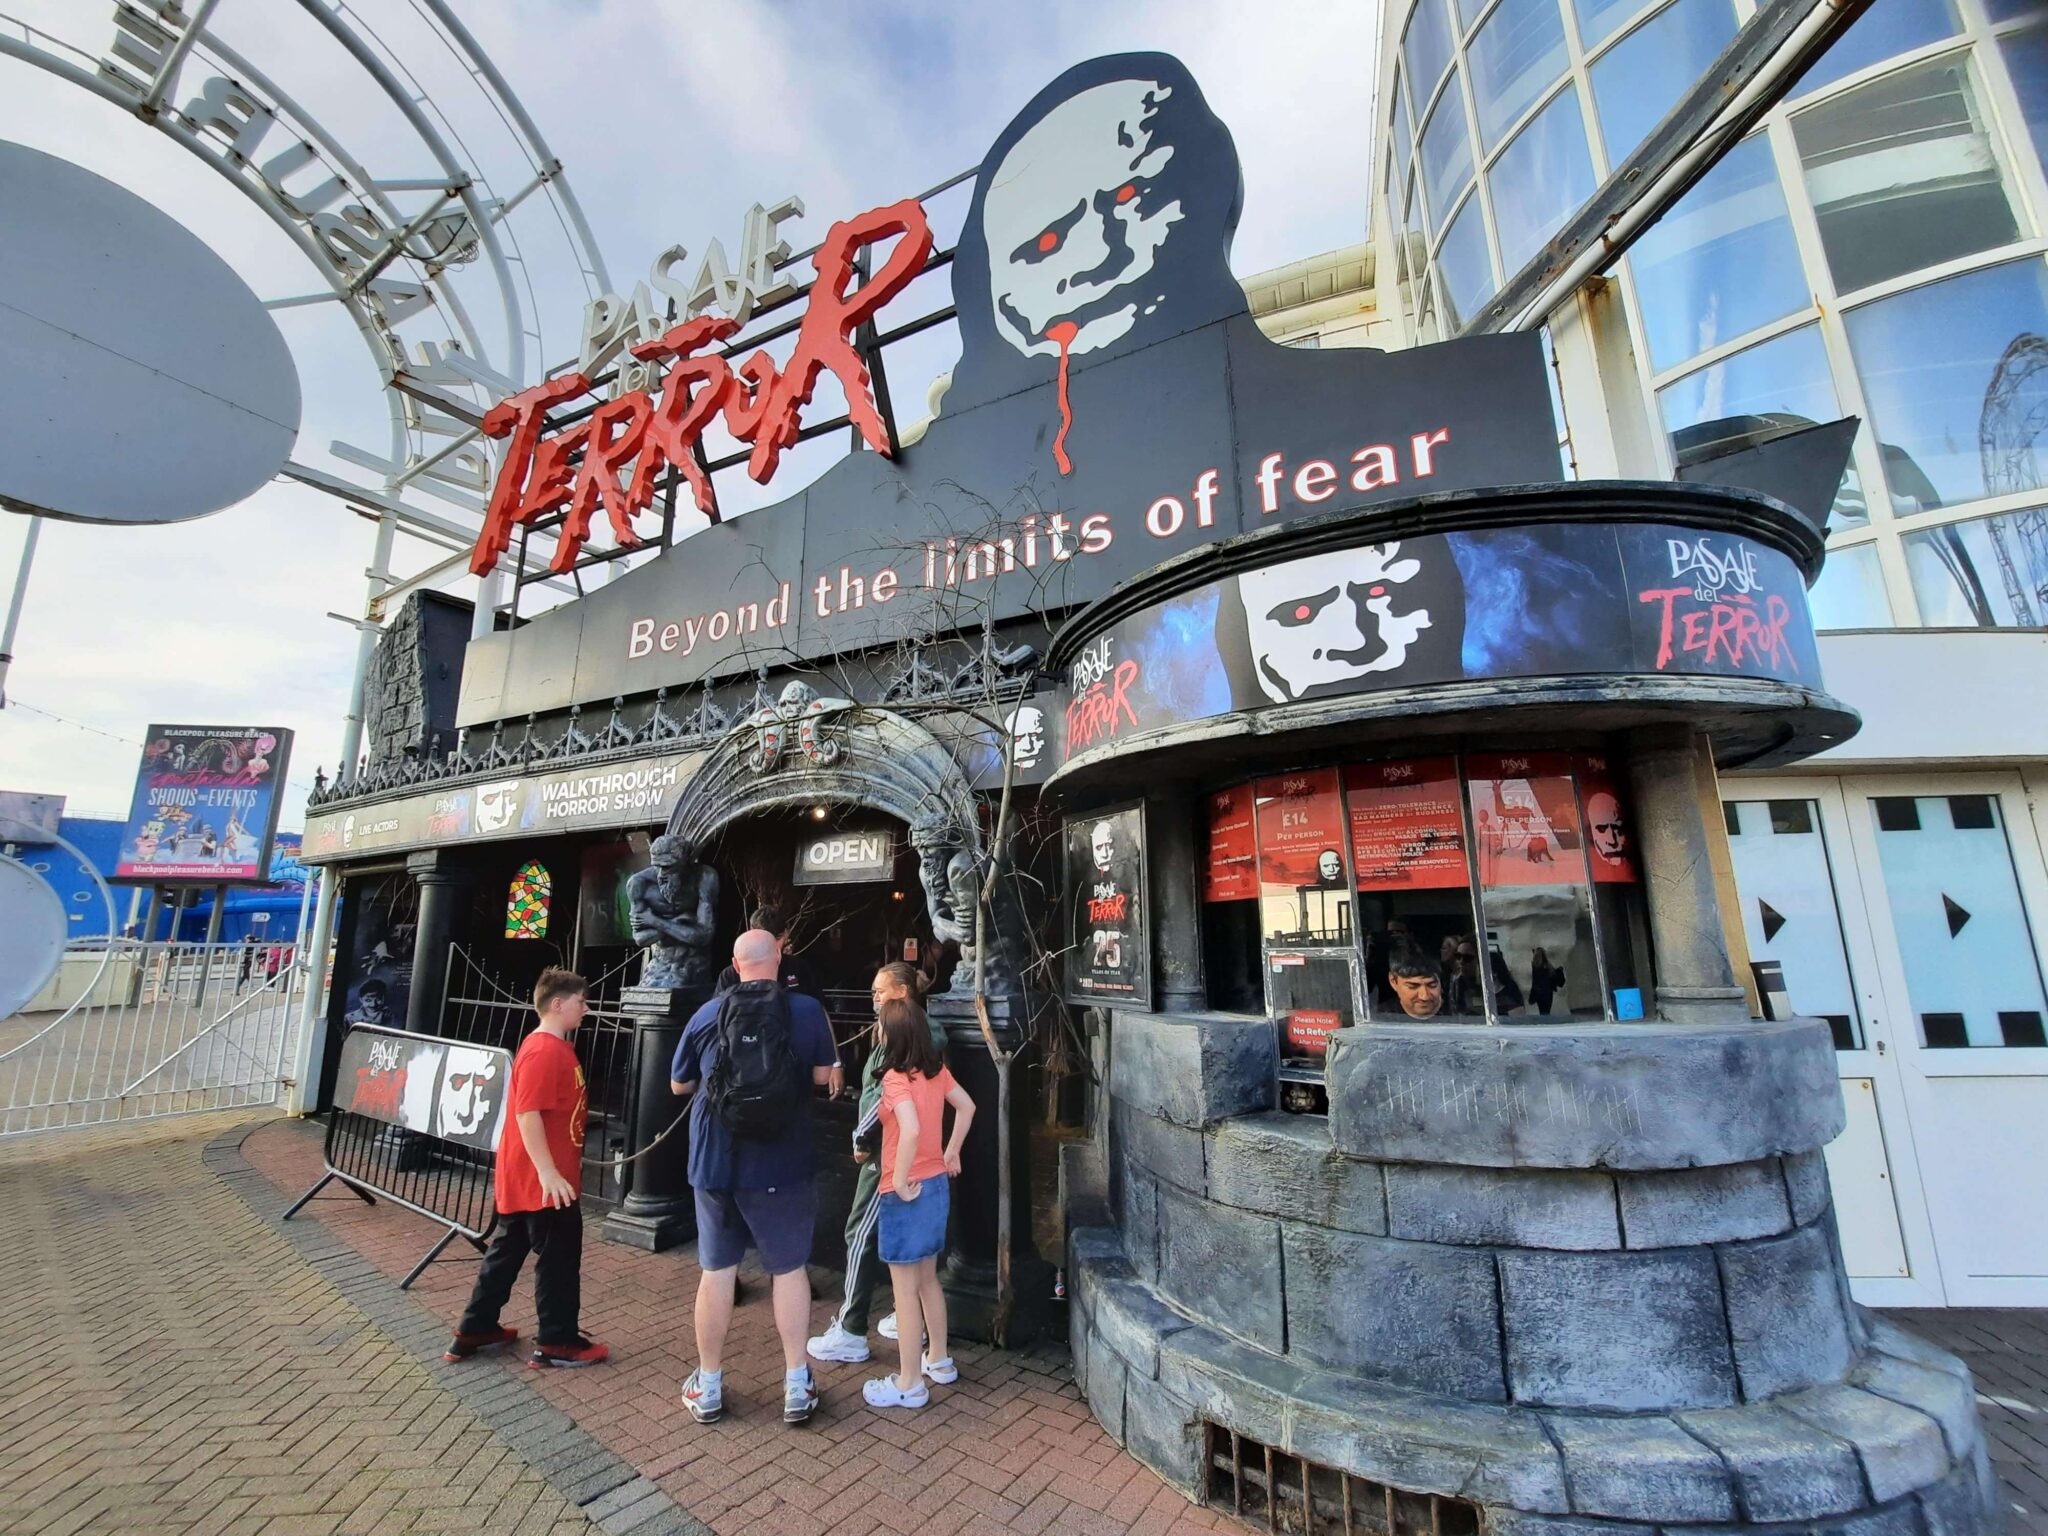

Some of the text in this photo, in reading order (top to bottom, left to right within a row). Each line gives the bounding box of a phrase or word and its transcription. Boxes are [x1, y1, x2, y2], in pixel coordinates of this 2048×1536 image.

[579, 195, 805, 376] PASAJE
[468, 198, 935, 577] TERROR
[626, 426, 1450, 662] Beyond the limits of fear
[1666, 537, 1764, 594] PASAJE
[1694, 581, 1722, 603] del
[1639, 587, 1799, 675] TERROR
[1072, 635, 1114, 695] PASAJE
[1064, 660, 1138, 763] TERROR
[164, 729, 269, 739] BLACKPOOL PLEASURE BEACH
[148, 788, 258, 807] SHOWS EVENTS
[542, 766, 676, 802] WALKTHROUGH
[546, 788, 665, 818] HORROR SHOW
[359, 819, 399, 836] LIVE ACTORS
[1277, 830, 1324, 841] PER PERSON
[809, 838, 879, 865] OPEN
[133, 864, 242, 875] blackpoolpleasurebeach.com
[1087, 894, 1126, 923] TERROR
[1093, 930, 1121, 968] 25
[1293, 1027, 1327, 1036] No Refu
[1294, 1016, 1315, 1025] Please
[368, 1040, 403, 1071] PASAJE
